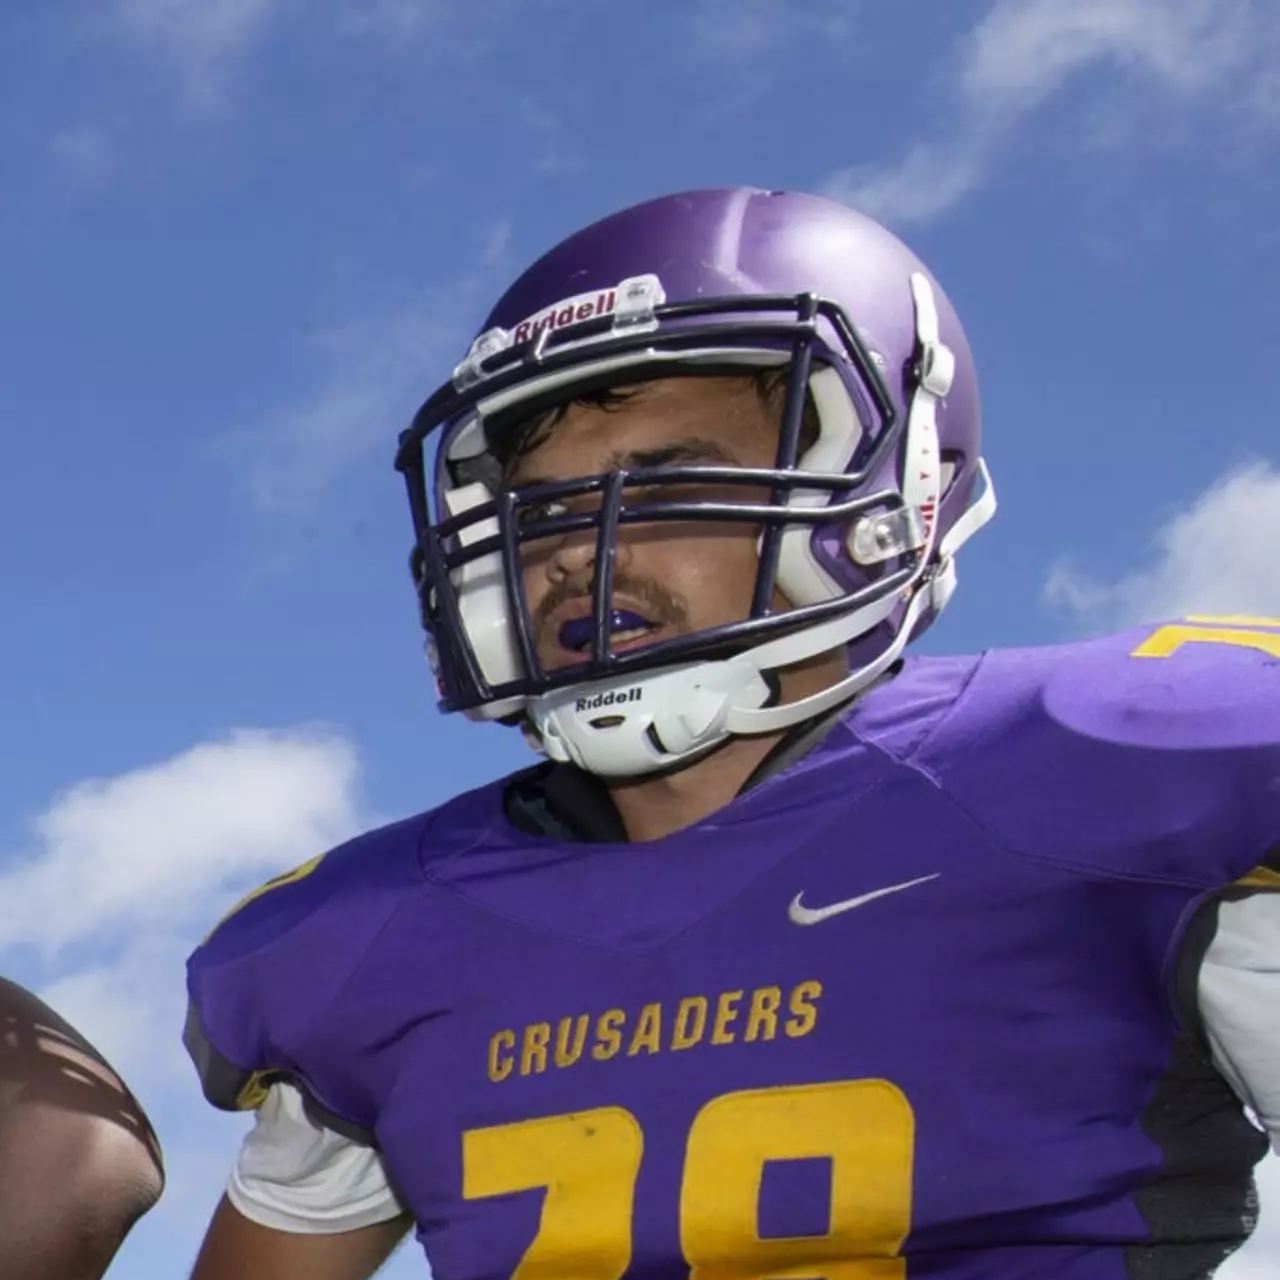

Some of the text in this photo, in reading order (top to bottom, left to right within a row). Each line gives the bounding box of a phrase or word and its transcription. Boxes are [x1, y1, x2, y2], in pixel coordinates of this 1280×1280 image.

[514, 290, 616, 343] Riddell
[576, 687, 642, 712] Riddell
[488, 980, 822, 1083] CRUSADERS
